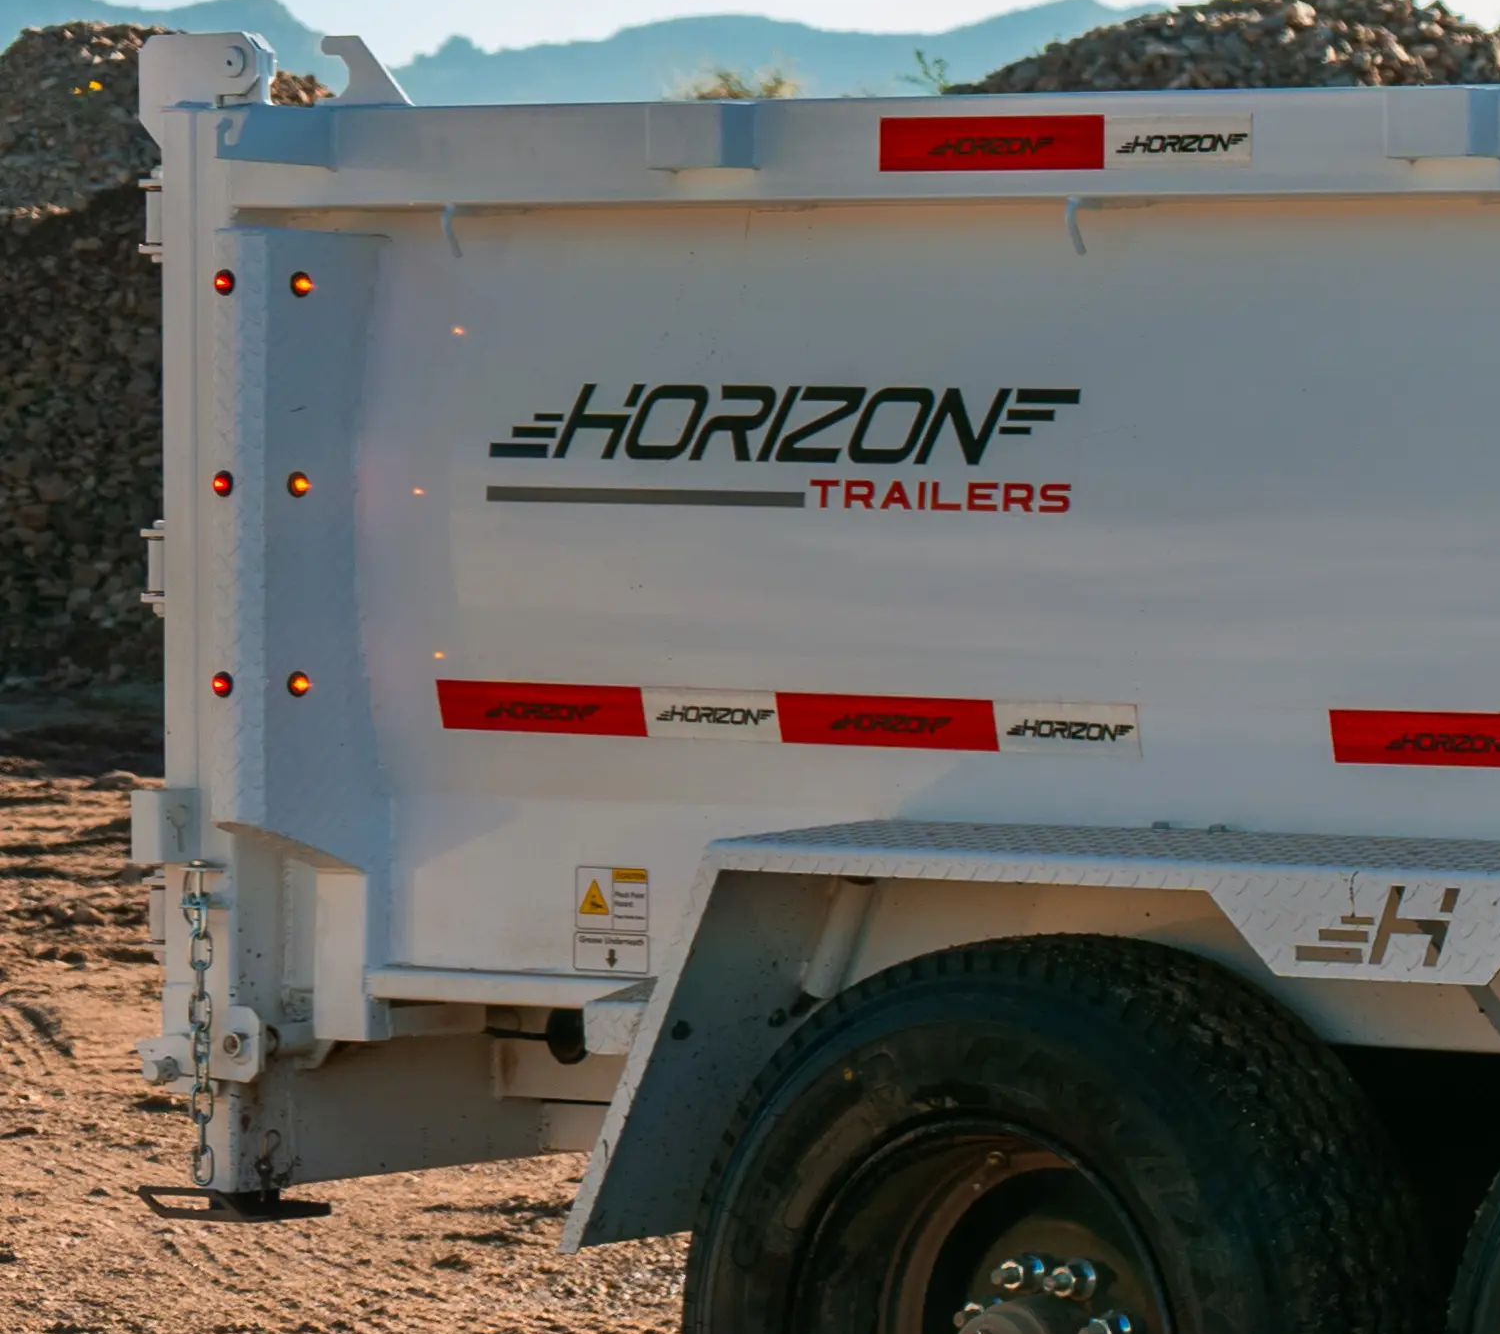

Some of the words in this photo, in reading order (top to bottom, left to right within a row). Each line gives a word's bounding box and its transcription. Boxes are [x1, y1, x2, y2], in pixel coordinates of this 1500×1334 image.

[1131, 133, 1234, 153] HORIZON
[553, 383, 1012, 465] HORIZON
[809, 478, 1072, 514] TRAILERS
[668, 705, 761, 725] HORIZON
[1021, 718, 1121, 741] HORIZON
